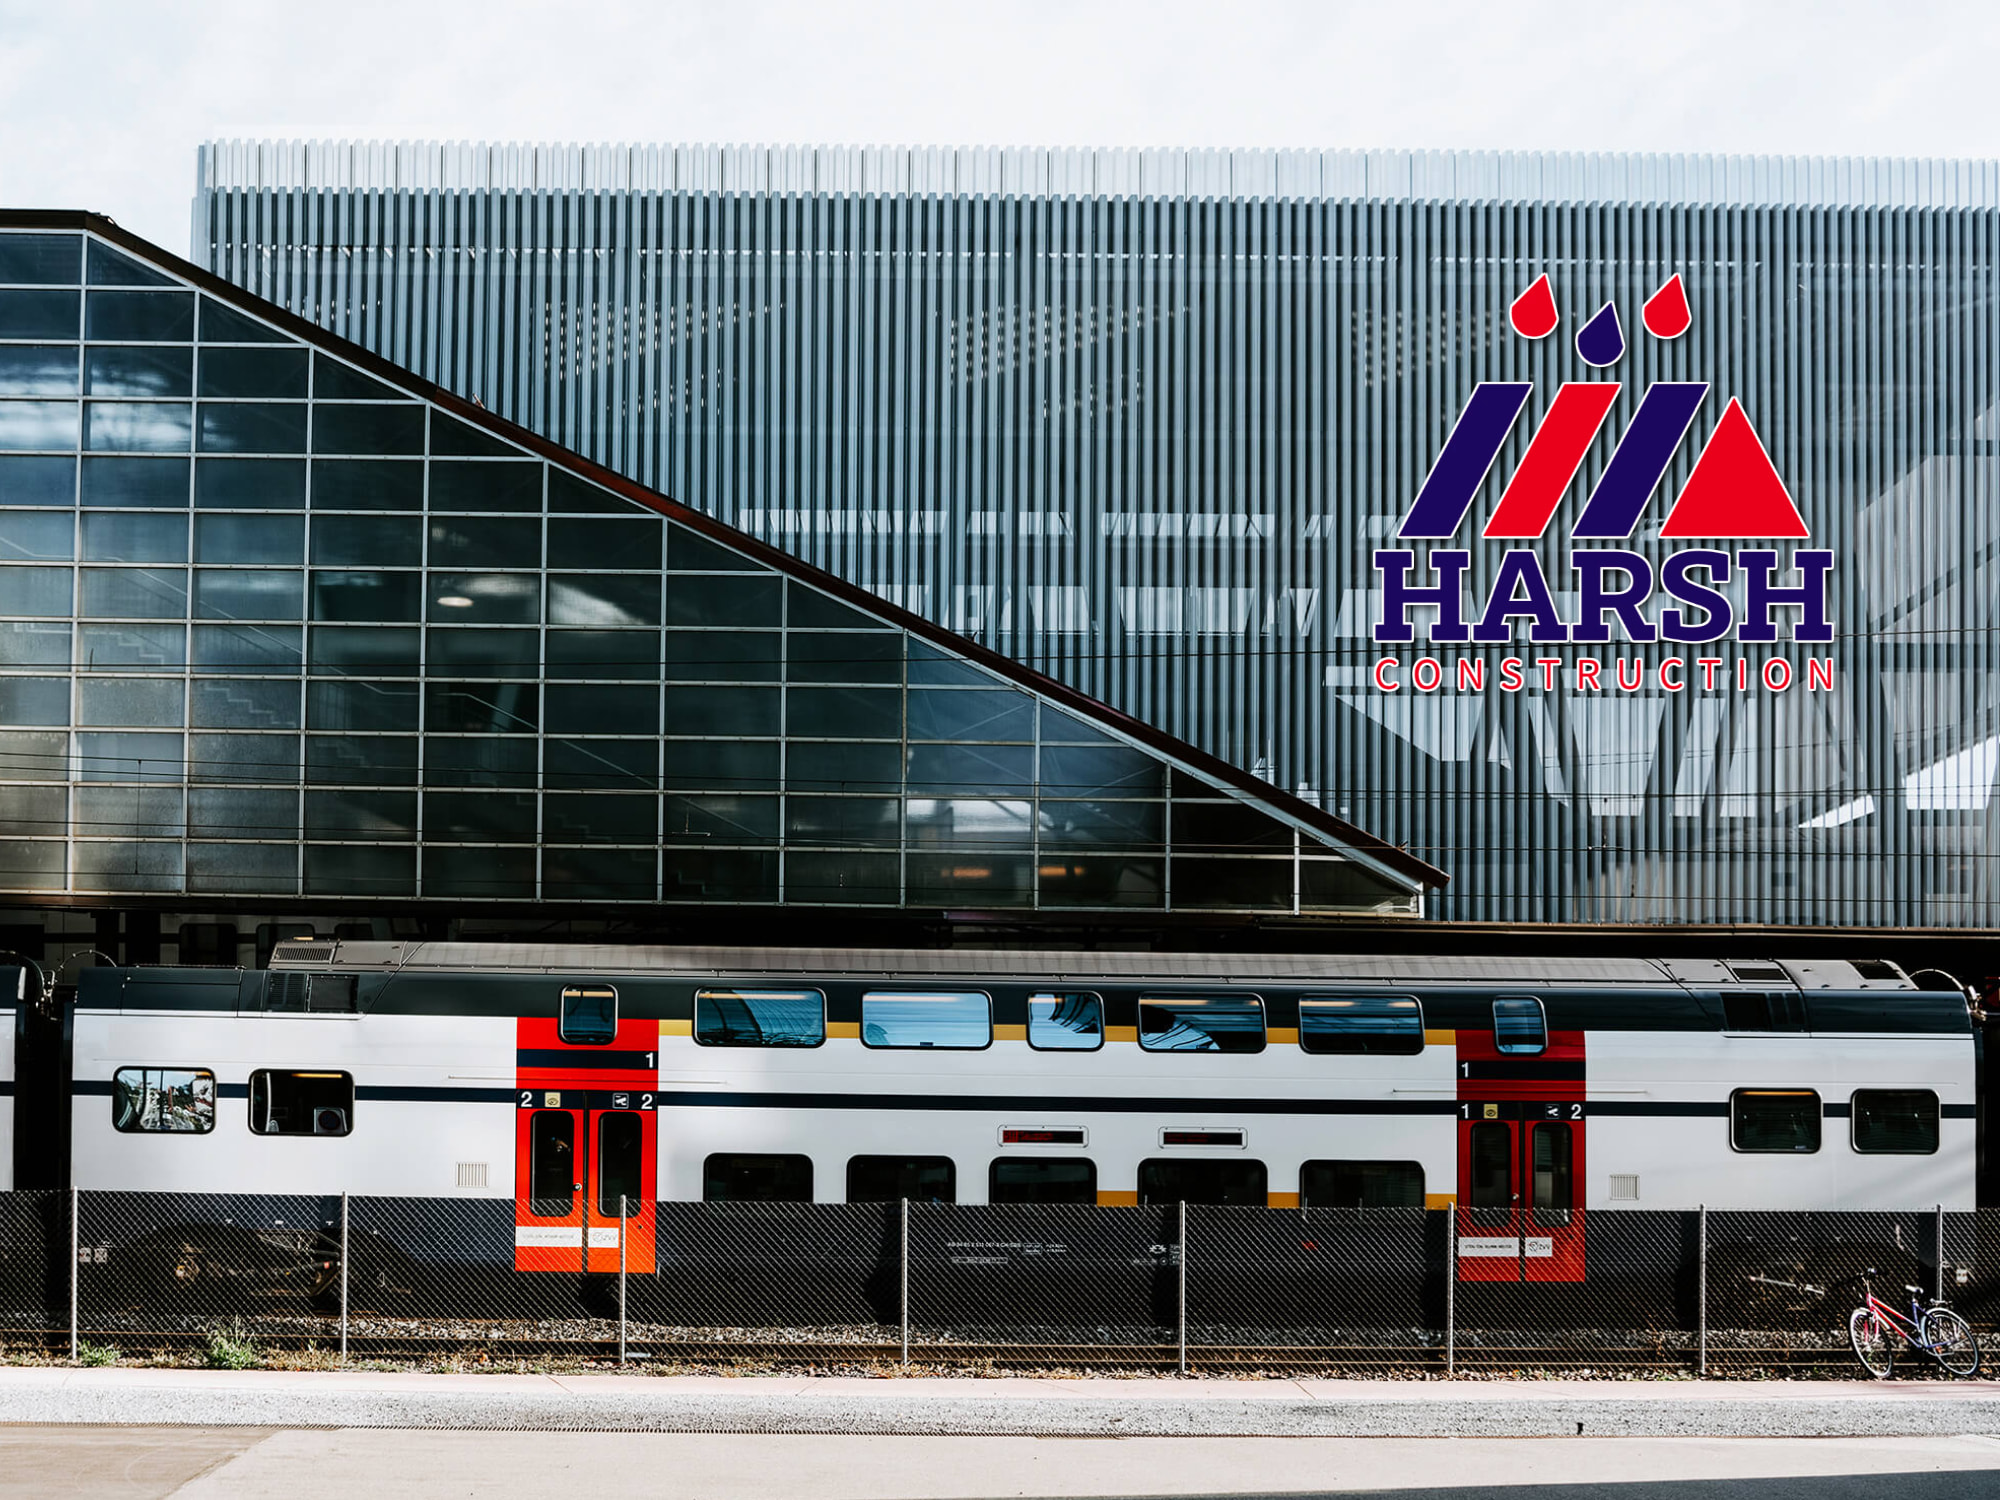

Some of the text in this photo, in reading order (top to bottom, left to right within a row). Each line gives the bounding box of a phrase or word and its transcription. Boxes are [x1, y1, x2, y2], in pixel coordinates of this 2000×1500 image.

[645, 1052, 654, 1068] 1
[1461, 1062, 1469, 1078] 1
[521, 1092, 533, 1108] 2
[641, 1093, 653, 1110] 2
[1461, 1103, 1469, 1119] 1
[1571, 1104, 1582, 1119] 2
